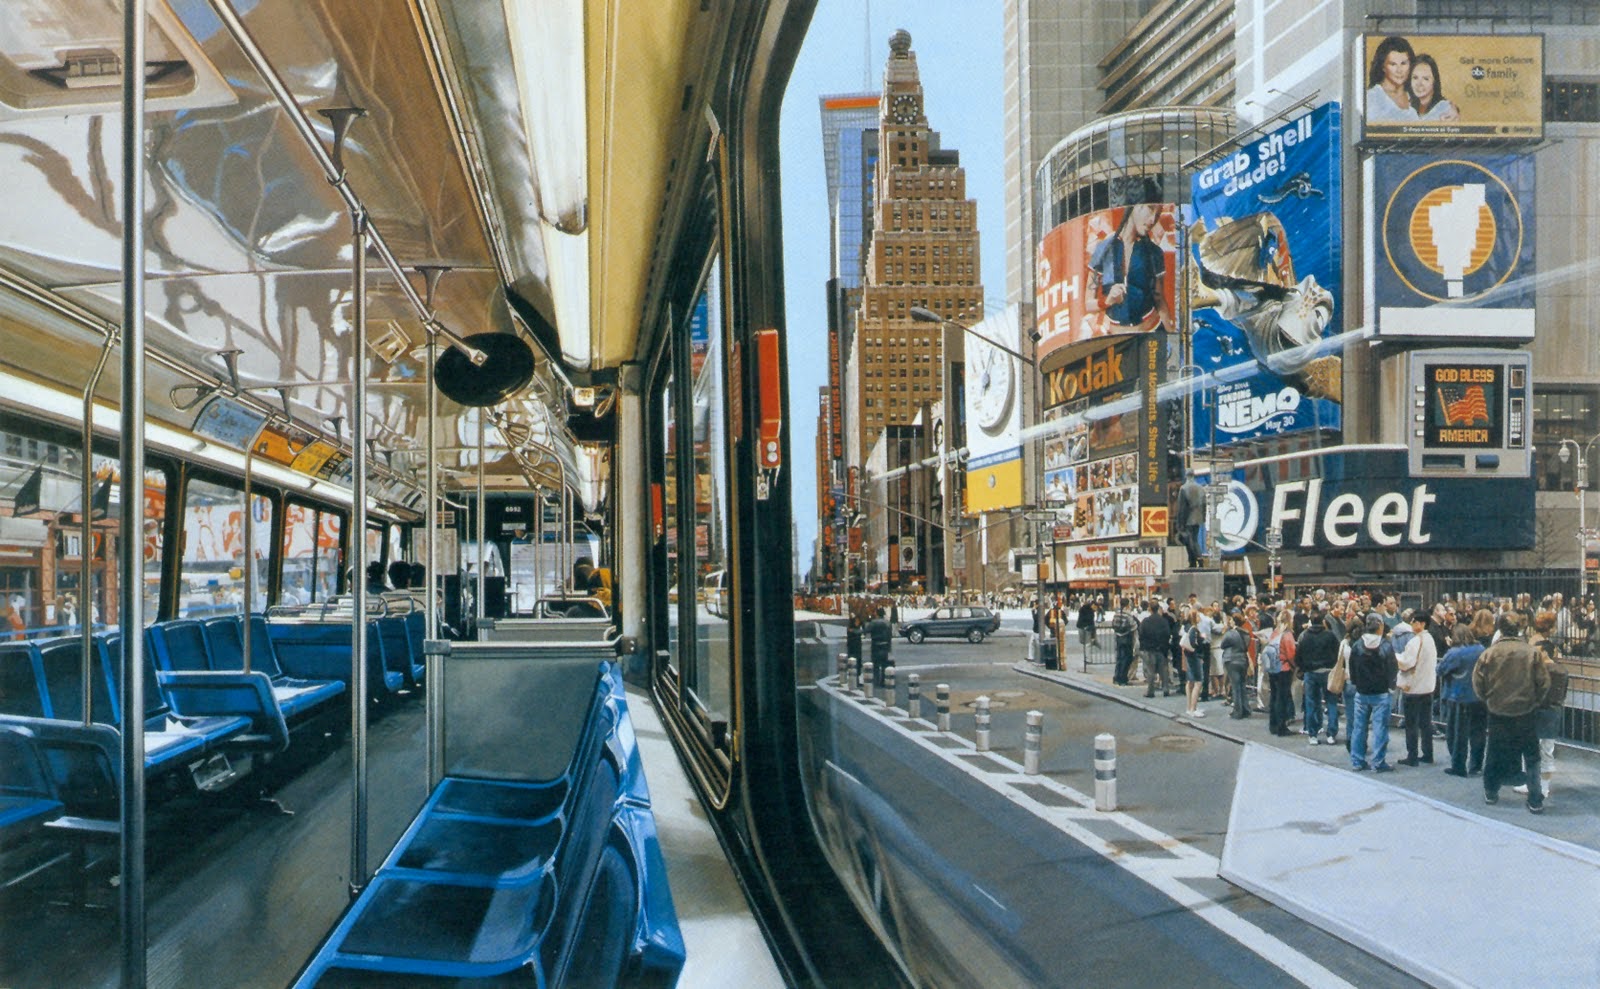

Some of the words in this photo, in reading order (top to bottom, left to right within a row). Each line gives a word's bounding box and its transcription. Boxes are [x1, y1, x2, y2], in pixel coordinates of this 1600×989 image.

[1486, 67, 1518, 81] family
[1199, 153, 1251, 190] Grab
[1258, 114, 1313, 161] shell
[1223, 151, 1287, 197] dude!
[1148, 340, 1158, 370] Share
[1049, 345, 1124, 405] Kodak
[1435, 368, 1458, 382] GOD
[1460, 368, 1495, 383] BLESS
[1148, 372, 1158, 424] Moments.
[1218, 386, 1300, 428] NEMO
[1265, 420, 1282, 432] May
[1282, 416, 1295, 428] 30
[1439, 429, 1489, 442] AMERICA
[1148, 427, 1158, 458] Share
[1271, 478, 1437, 547] Fleet
